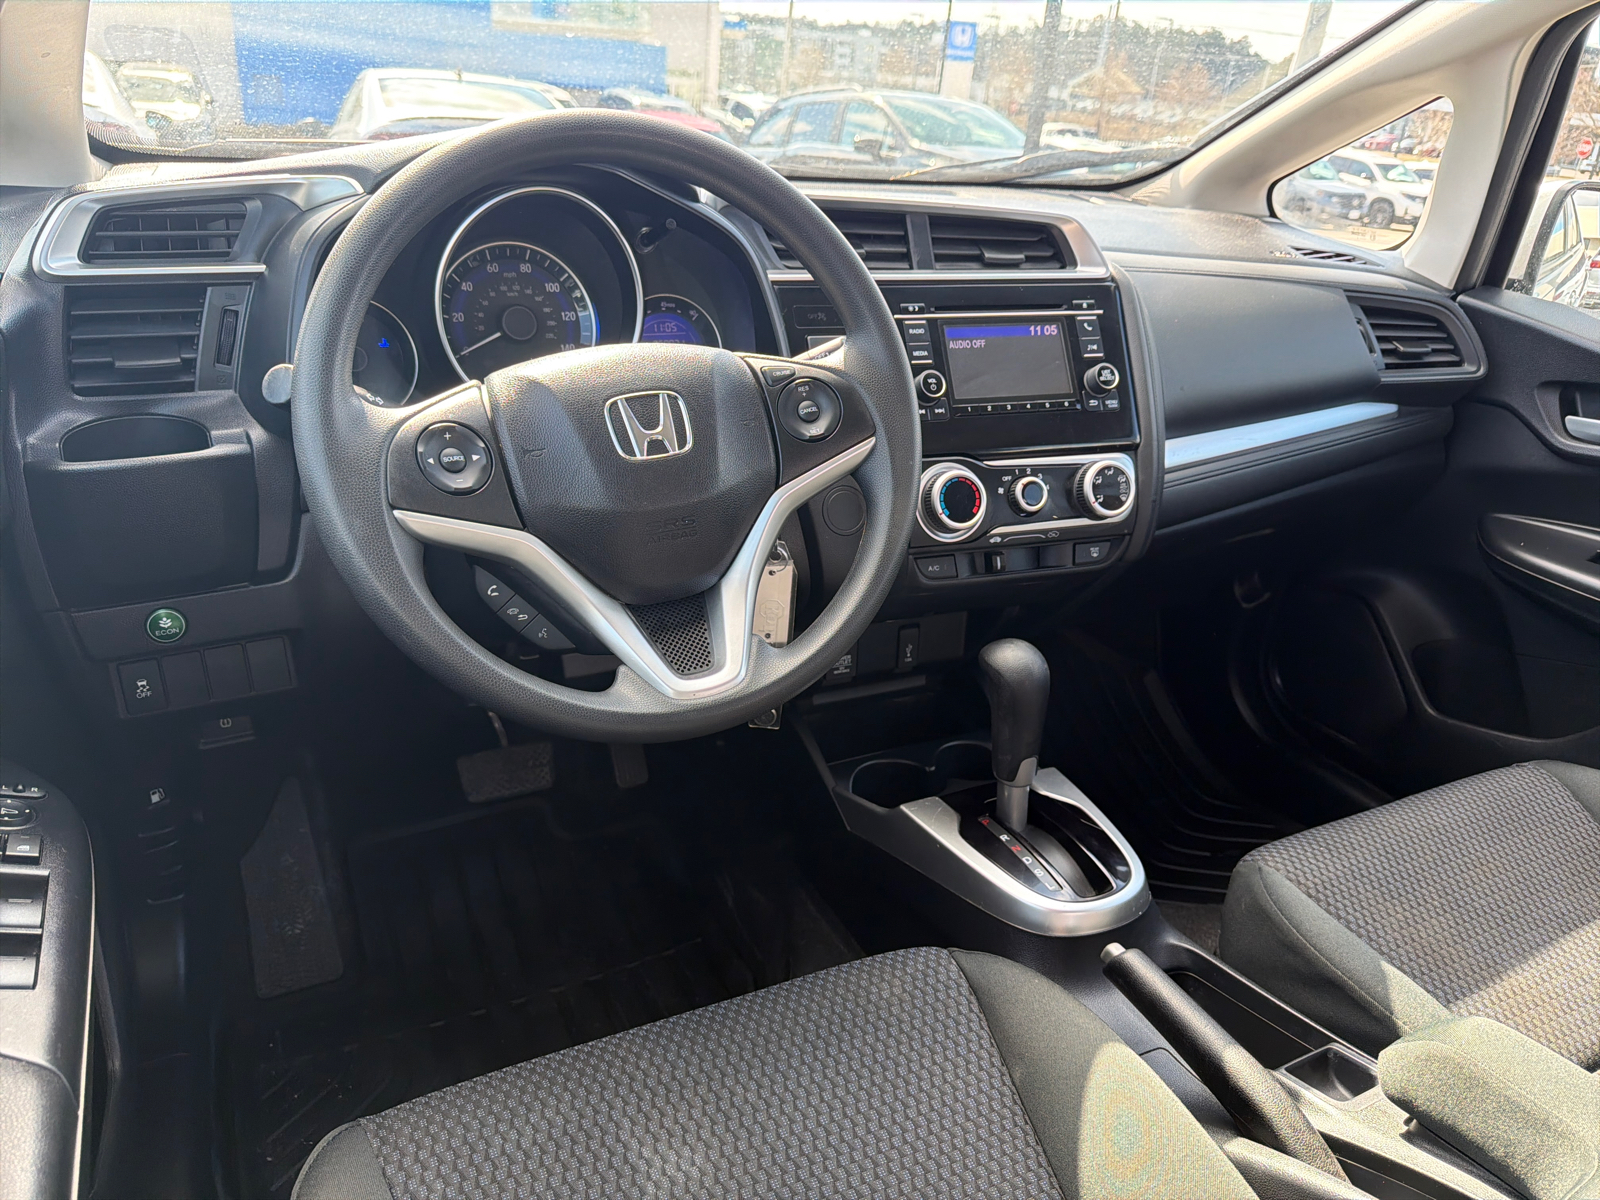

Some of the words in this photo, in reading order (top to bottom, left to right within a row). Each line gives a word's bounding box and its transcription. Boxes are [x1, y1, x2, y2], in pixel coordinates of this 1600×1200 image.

[487, 263, 499, 273] 60
[520, 263, 532, 273] 80
[461, 282, 473, 292] 40
[545, 283, 560, 293] 100
[452, 313, 465, 322] 20
[561, 312, 576, 321] 120
[654, 322, 677, 332] 11:05
[949, 340, 971, 349] AUDIO
[972, 340, 986, 348] OFF
[800, 406, 819, 415] CANCEL
[443, 455, 465, 463] SOURCE
[928, 564, 940, 572] A/C
[155, 627, 180, 637] ECON
[136, 690, 152, 699] OFF
[1000, 834, 1010, 842] R
[1011, 845, 1022, 853] N
[1022, 856, 1033, 865] D
[1034, 868, 1045, 877] S
[1045, 882, 1056, 890] L
